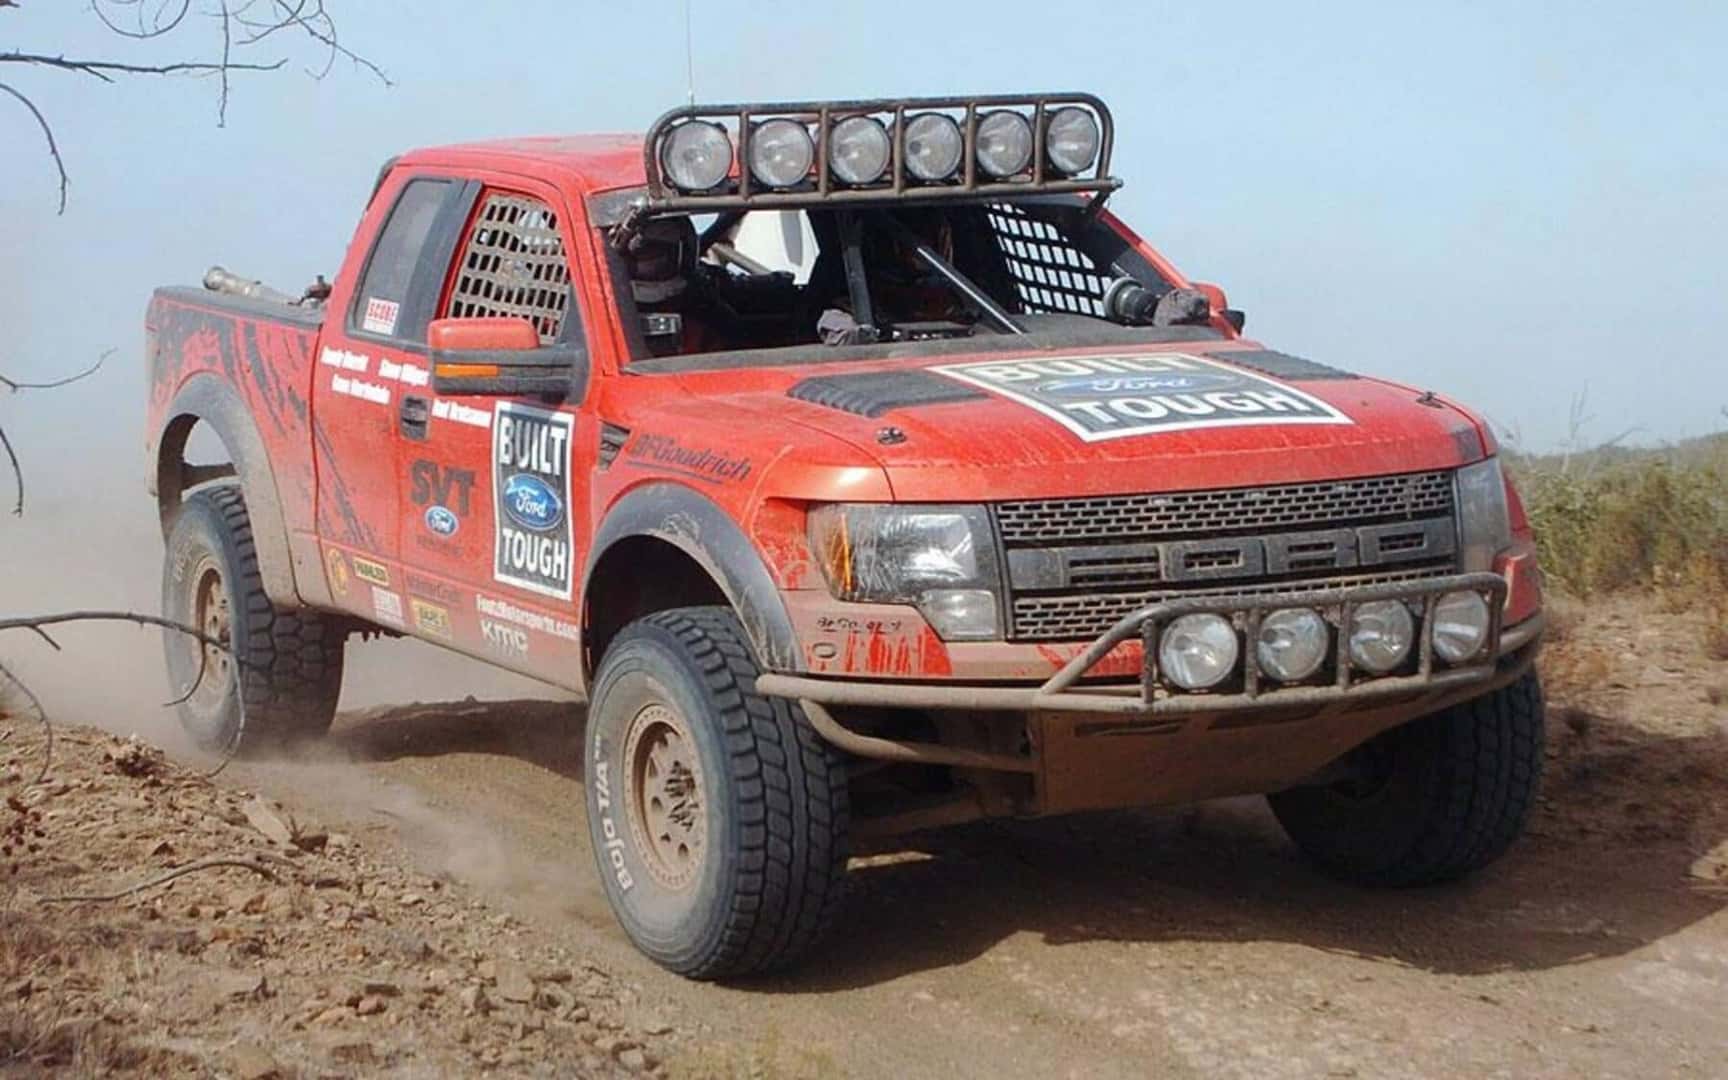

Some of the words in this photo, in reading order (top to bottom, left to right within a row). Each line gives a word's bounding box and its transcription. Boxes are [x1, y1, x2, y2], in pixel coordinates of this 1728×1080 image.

[967, 356, 1202, 383] BUILT
[1090, 371, 1193, 392] Ford
[1063, 390, 1304, 424] TOUGH
[499, 416, 566, 475] BUILT
[411, 458, 477, 518] SVT
[506, 484, 548, 518] Ford
[502, 528, 567, 581] TOUGH
